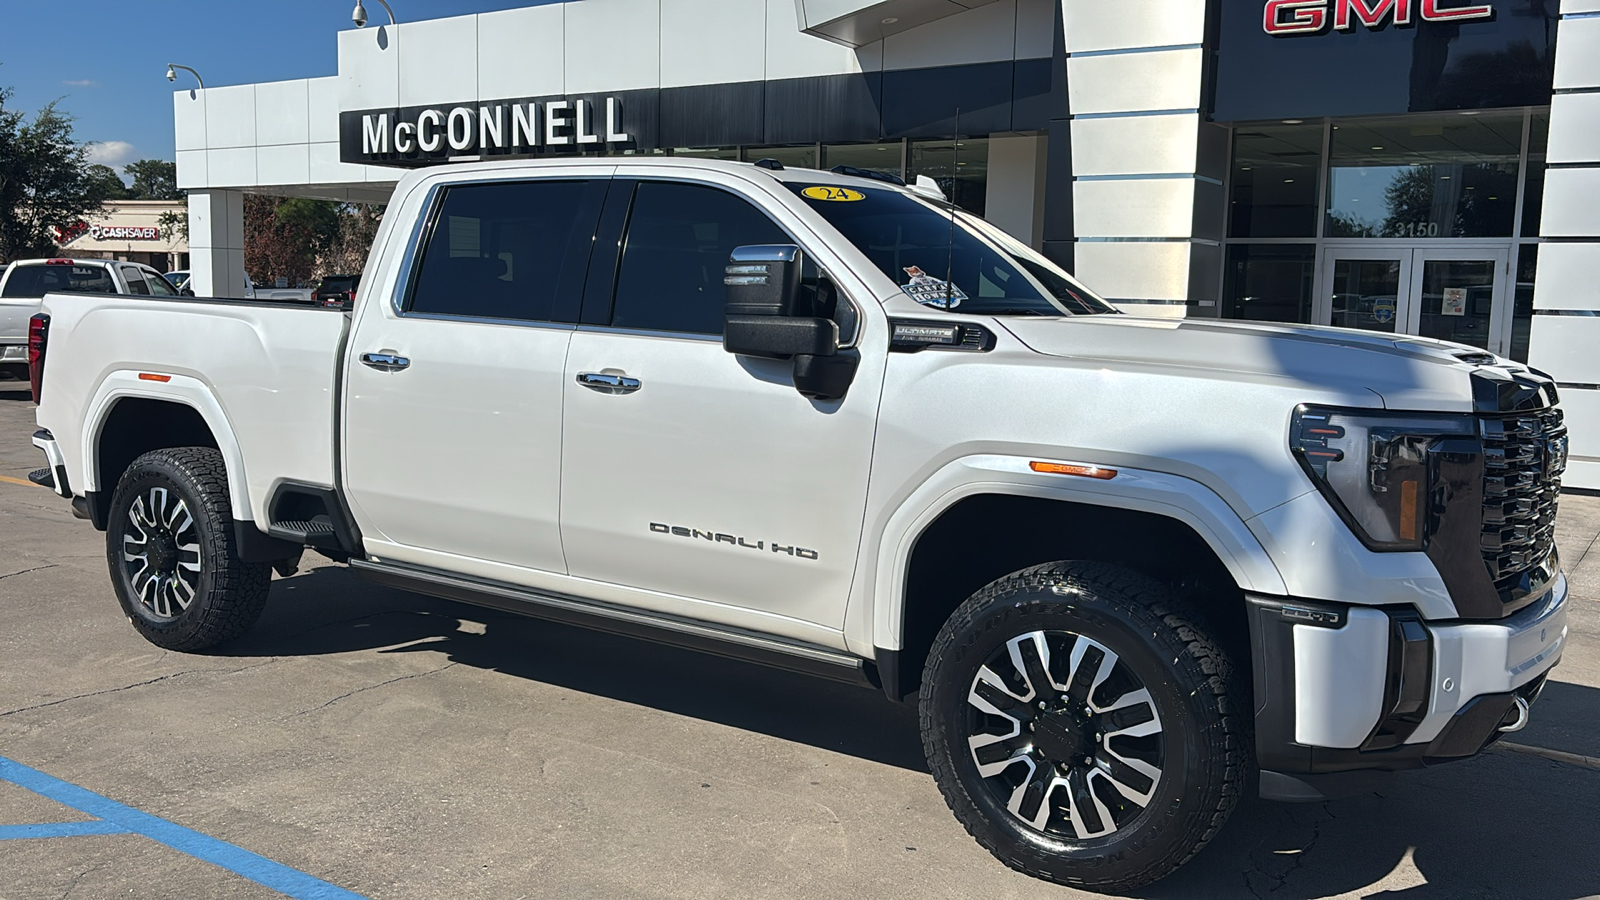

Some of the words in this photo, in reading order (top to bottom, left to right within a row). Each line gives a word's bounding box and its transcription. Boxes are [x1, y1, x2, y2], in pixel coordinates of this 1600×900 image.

[1262, 0, 1492, 34] GMC
[362, 97, 628, 154] McCONNELL
[819, 187, 849, 200] 24
[1395, 222, 1438, 237] 3150
[896, 327, 953, 336] ULTIMATE
[650, 522, 764, 550] DENALI
[772, 542, 818, 560] HD
